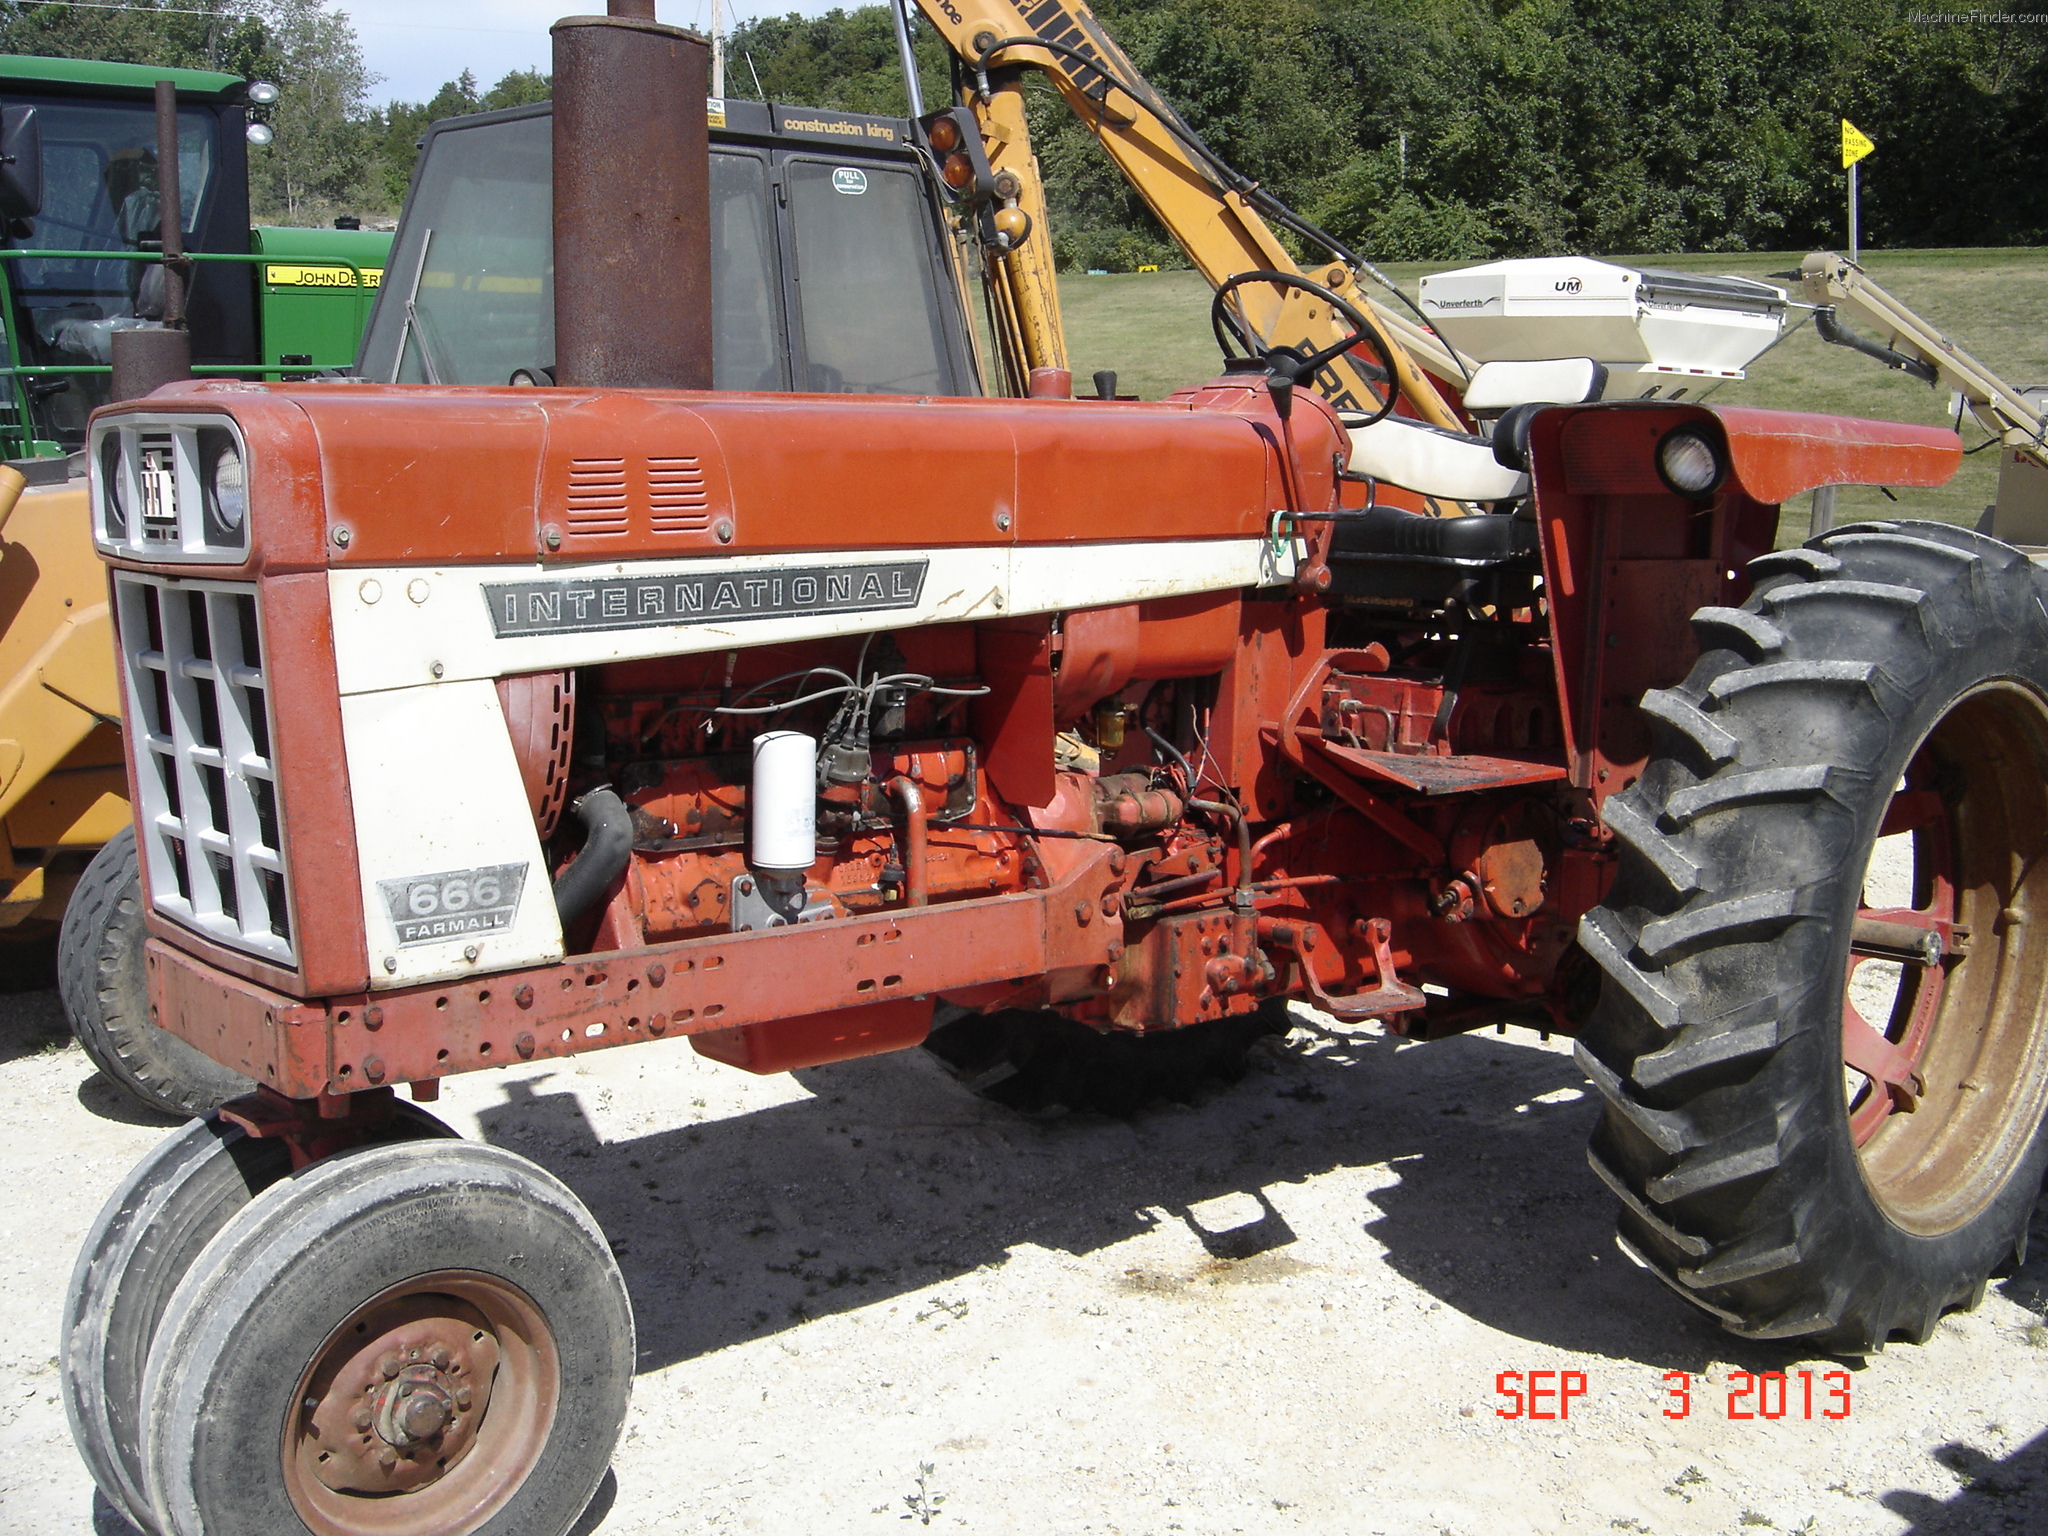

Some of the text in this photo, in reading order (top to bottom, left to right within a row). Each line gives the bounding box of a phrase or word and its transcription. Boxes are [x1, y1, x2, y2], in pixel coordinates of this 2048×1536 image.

[783, 119, 894, 141] construction king
[1844, 127, 1855, 135] NO
[1844, 138, 1867, 147] PASSING
[1845, 149, 1859, 157] ZONE
[838, 171, 860, 180] PULL
[339, 271, 383, 286] DEER
[1439, 299, 1484, 309] Unverferth
[505, 570, 913, 625] INTERNATIONAL
[409, 875, 501, 916] 666
[406, 914, 505, 939] FARMALL
